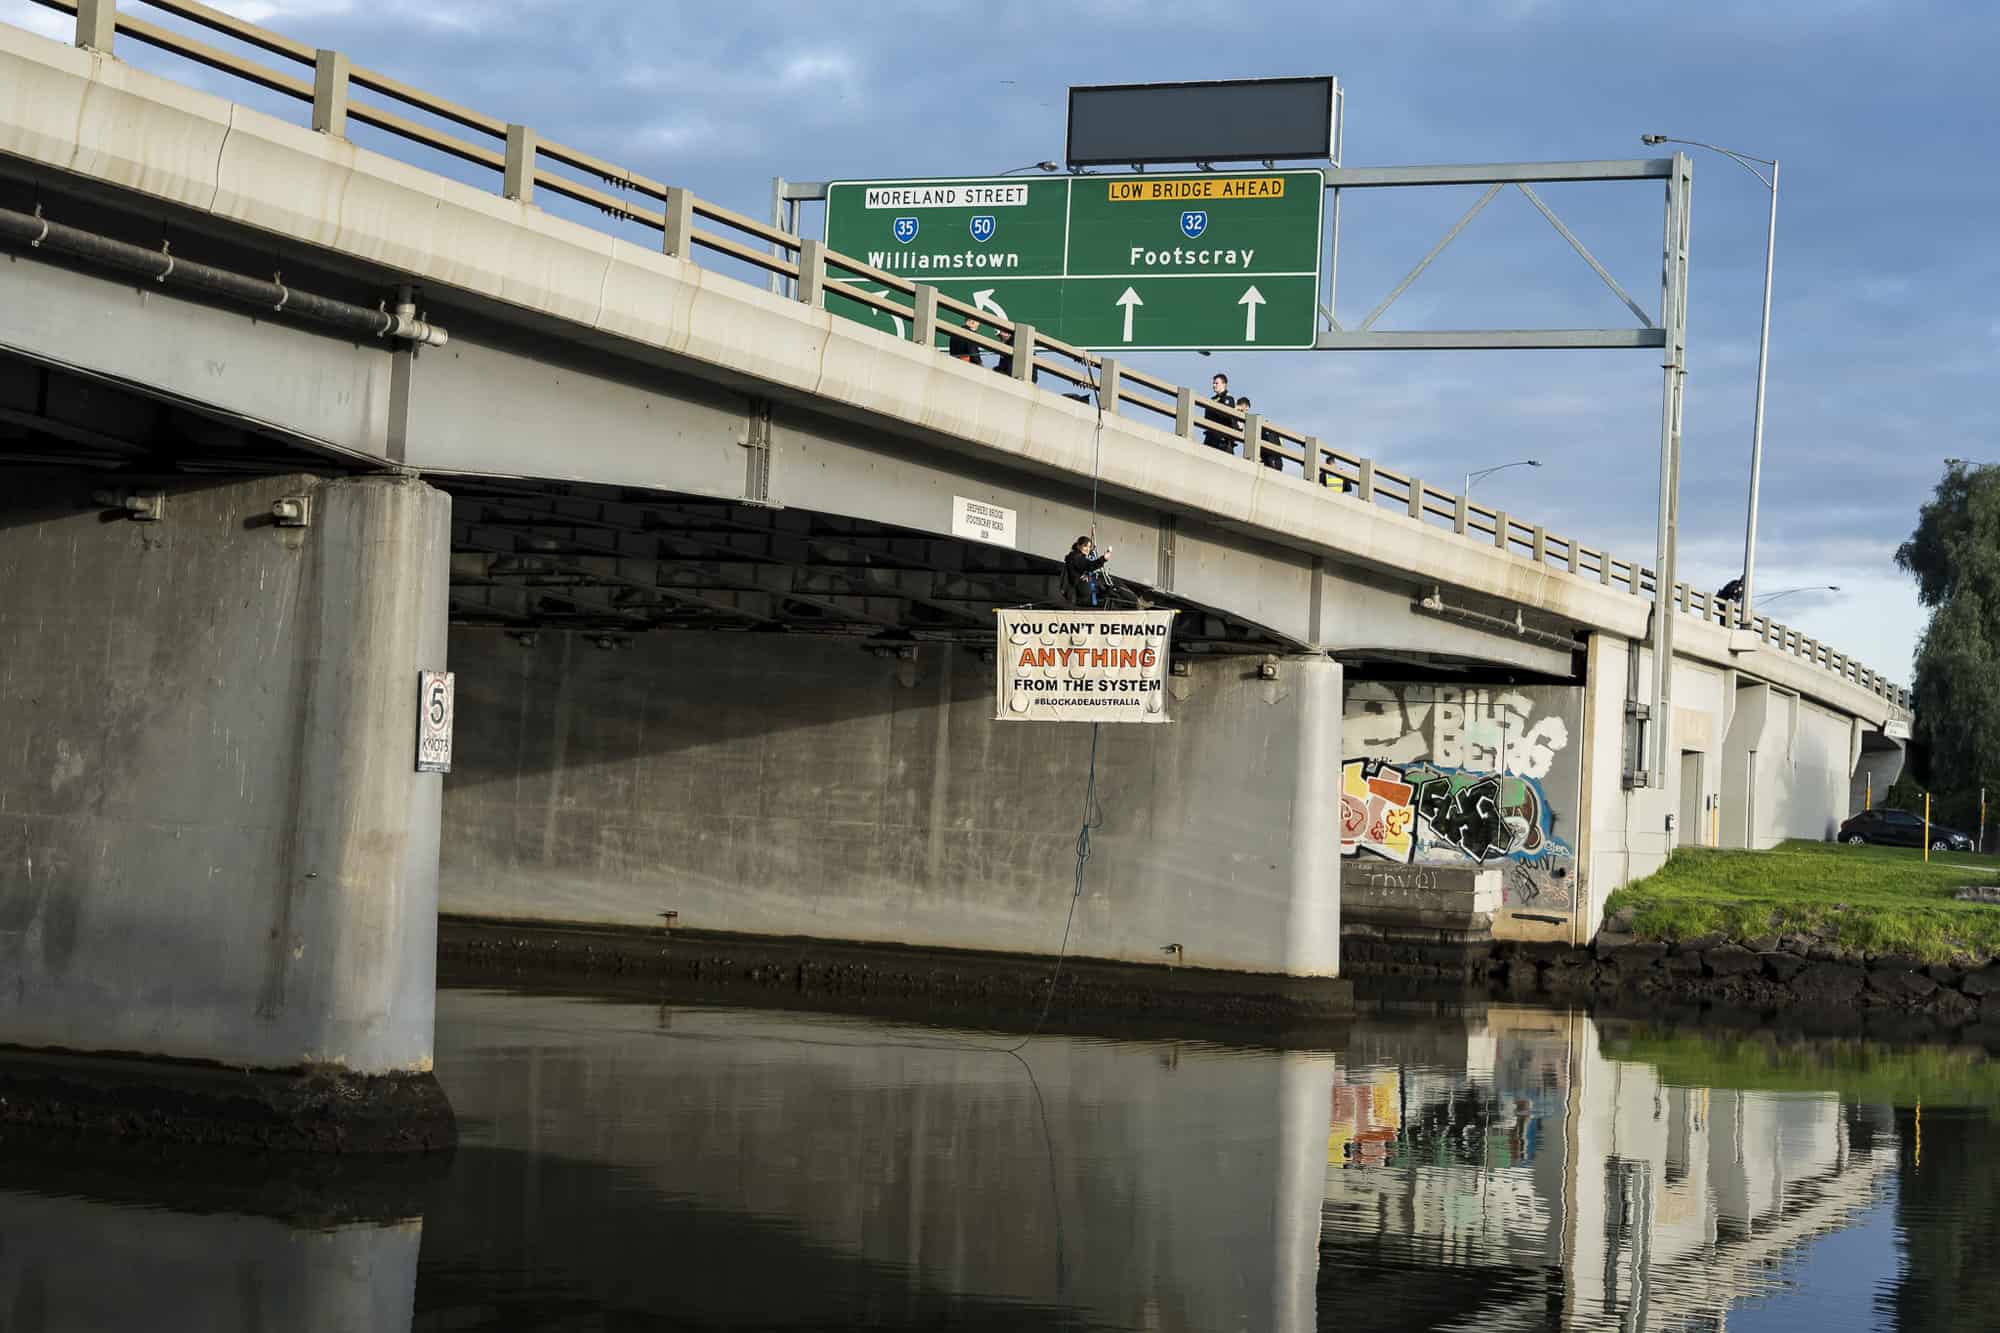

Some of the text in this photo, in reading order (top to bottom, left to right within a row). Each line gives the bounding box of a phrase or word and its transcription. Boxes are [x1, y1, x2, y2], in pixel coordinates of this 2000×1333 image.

[868, 188, 1025, 205] MORELAND STREET
[1111, 179, 1282, 199] LOW BRIDGE AHEAD
[898, 220, 914, 236] 35
[974, 219, 991, 235] 50
[1185, 214, 1203, 231] 32
[867, 250, 1019, 270] Williamstown
[1130, 247, 1255, 268] Footscray
[1011, 622, 1166, 636] YOU CAN'T DEMAND
[1018, 647, 1156, 668] ANYTHING
[1014, 679, 1161, 692] FROM THE SYSTEM
[430, 687, 445, 724] 5
[1034, 698, 1141, 707] #BLOCKADEAUSTRALIA
[423, 736, 449, 753] KNOTS
